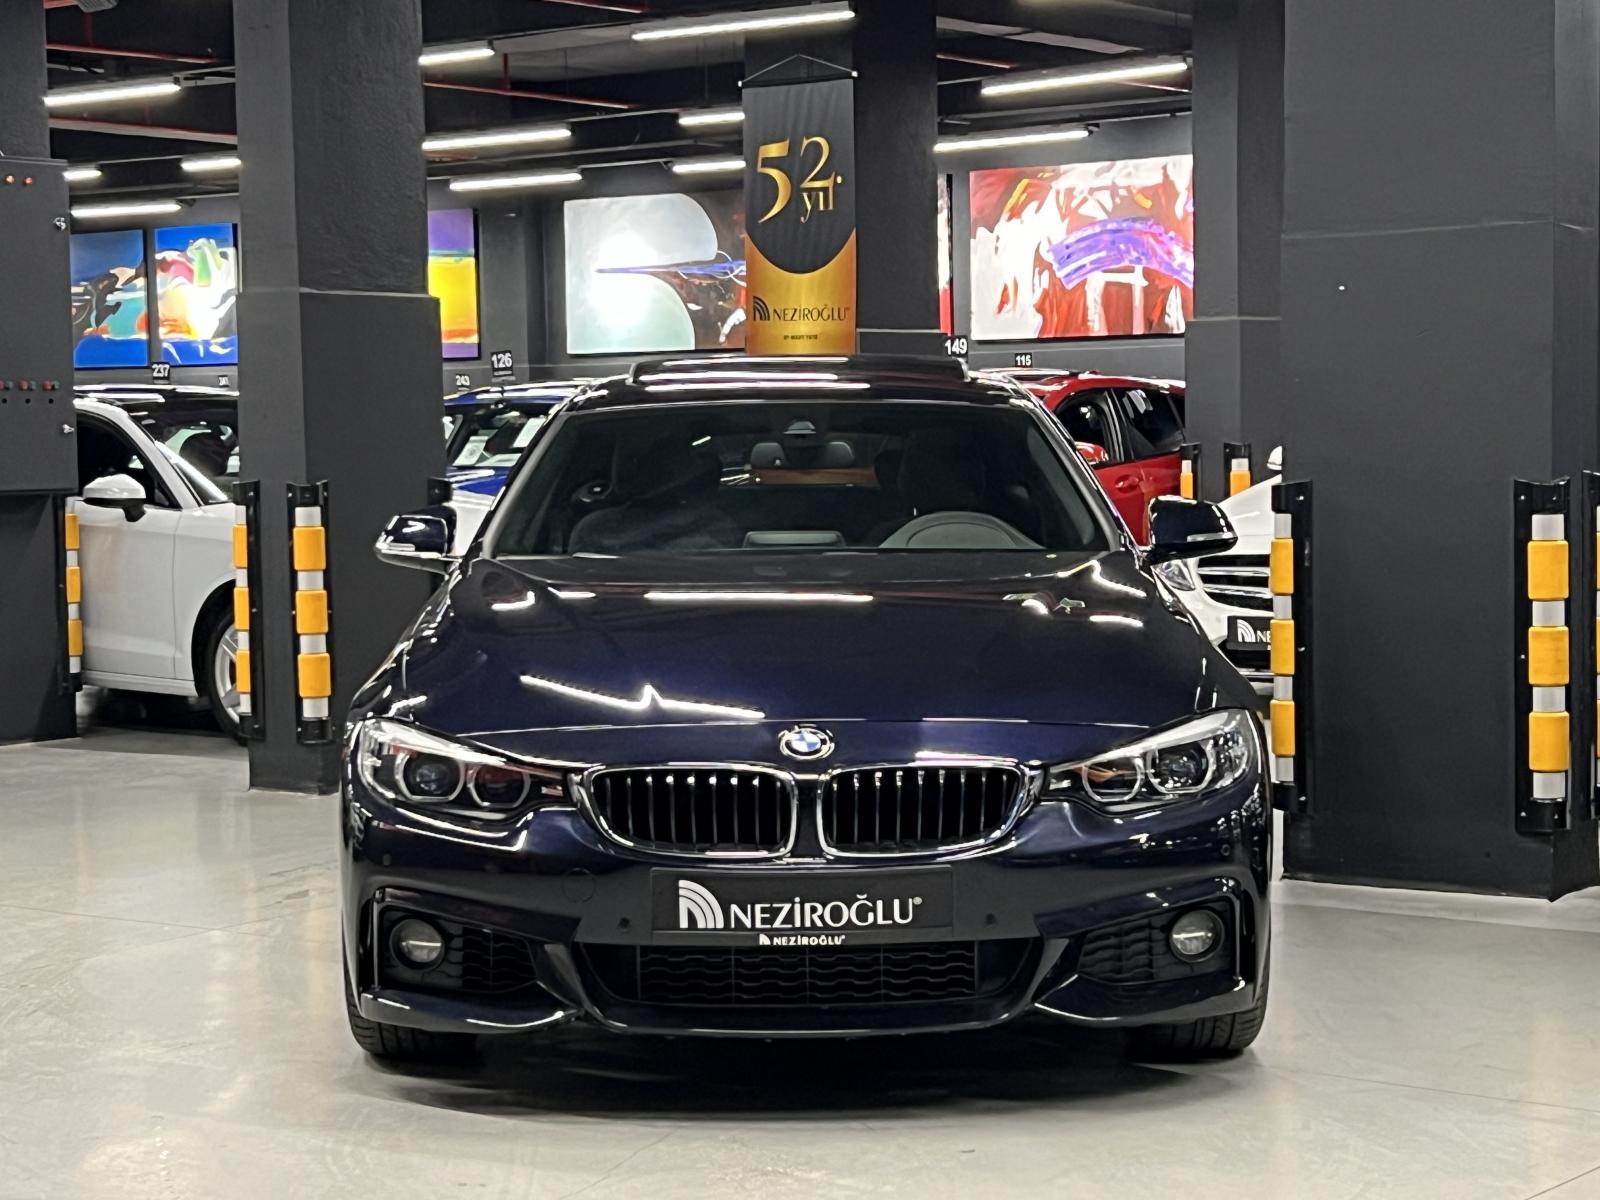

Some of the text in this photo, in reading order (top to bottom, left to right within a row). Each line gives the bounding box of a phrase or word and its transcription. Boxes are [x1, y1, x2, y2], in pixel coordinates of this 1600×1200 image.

[945, 338, 967, 355] 149
[491, 352, 513, 368] 126
[152, 363, 170, 377] 237
[730, 894, 914, 929] NEZİROĞLU
